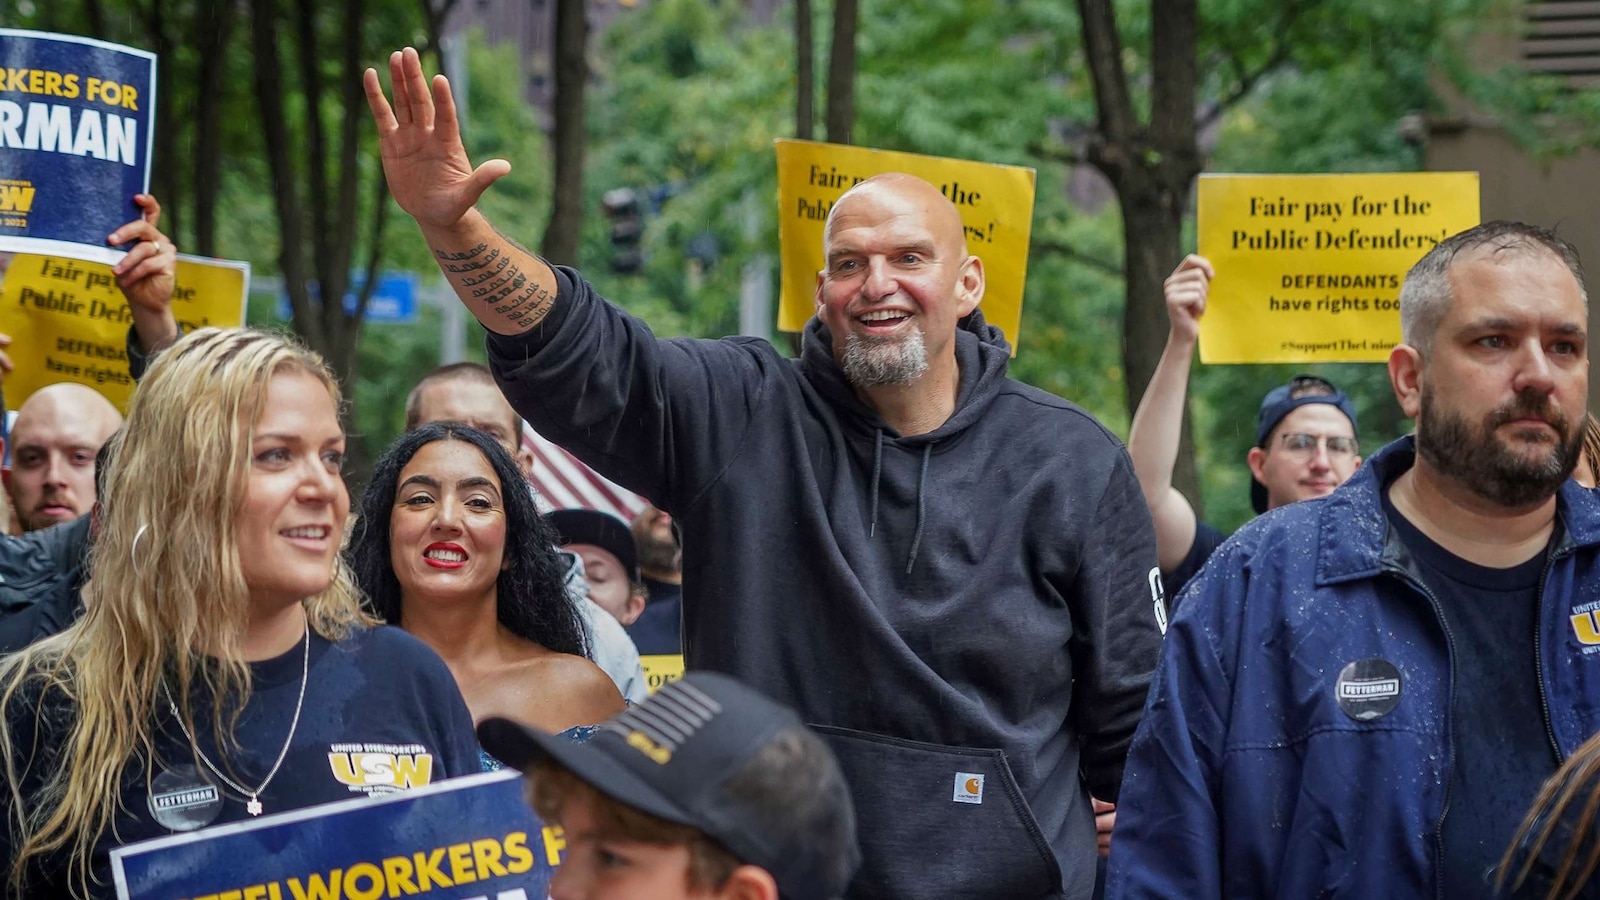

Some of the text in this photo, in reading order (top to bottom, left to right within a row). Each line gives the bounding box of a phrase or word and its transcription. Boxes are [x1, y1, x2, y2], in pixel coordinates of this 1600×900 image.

[86, 77, 138, 111] FOR
[0, 100, 137, 166] RMAN
[810, 164, 848, 189] Fair
[941, 182, 981, 207] the
[797, 197, 834, 221] Publ
[1250, 194, 1432, 223] Fair pay for the
[1231, 229, 1309, 250] Public
[41, 258, 83, 282] Fair
[173, 278, 196, 300] he
[1281, 274, 1399, 289] DEFENDANTS
[19, 286, 86, 315] Public
[1269, 296, 1312, 311] have
[1317, 296, 1369, 314] rights
[643, 667, 676, 688] or
[1345, 683, 1394, 695] FETTERMAN
[327, 752, 433, 790] USW
[159, 789, 213, 808] FETTERMAN
[176, 831, 534, 900] WORKERS
